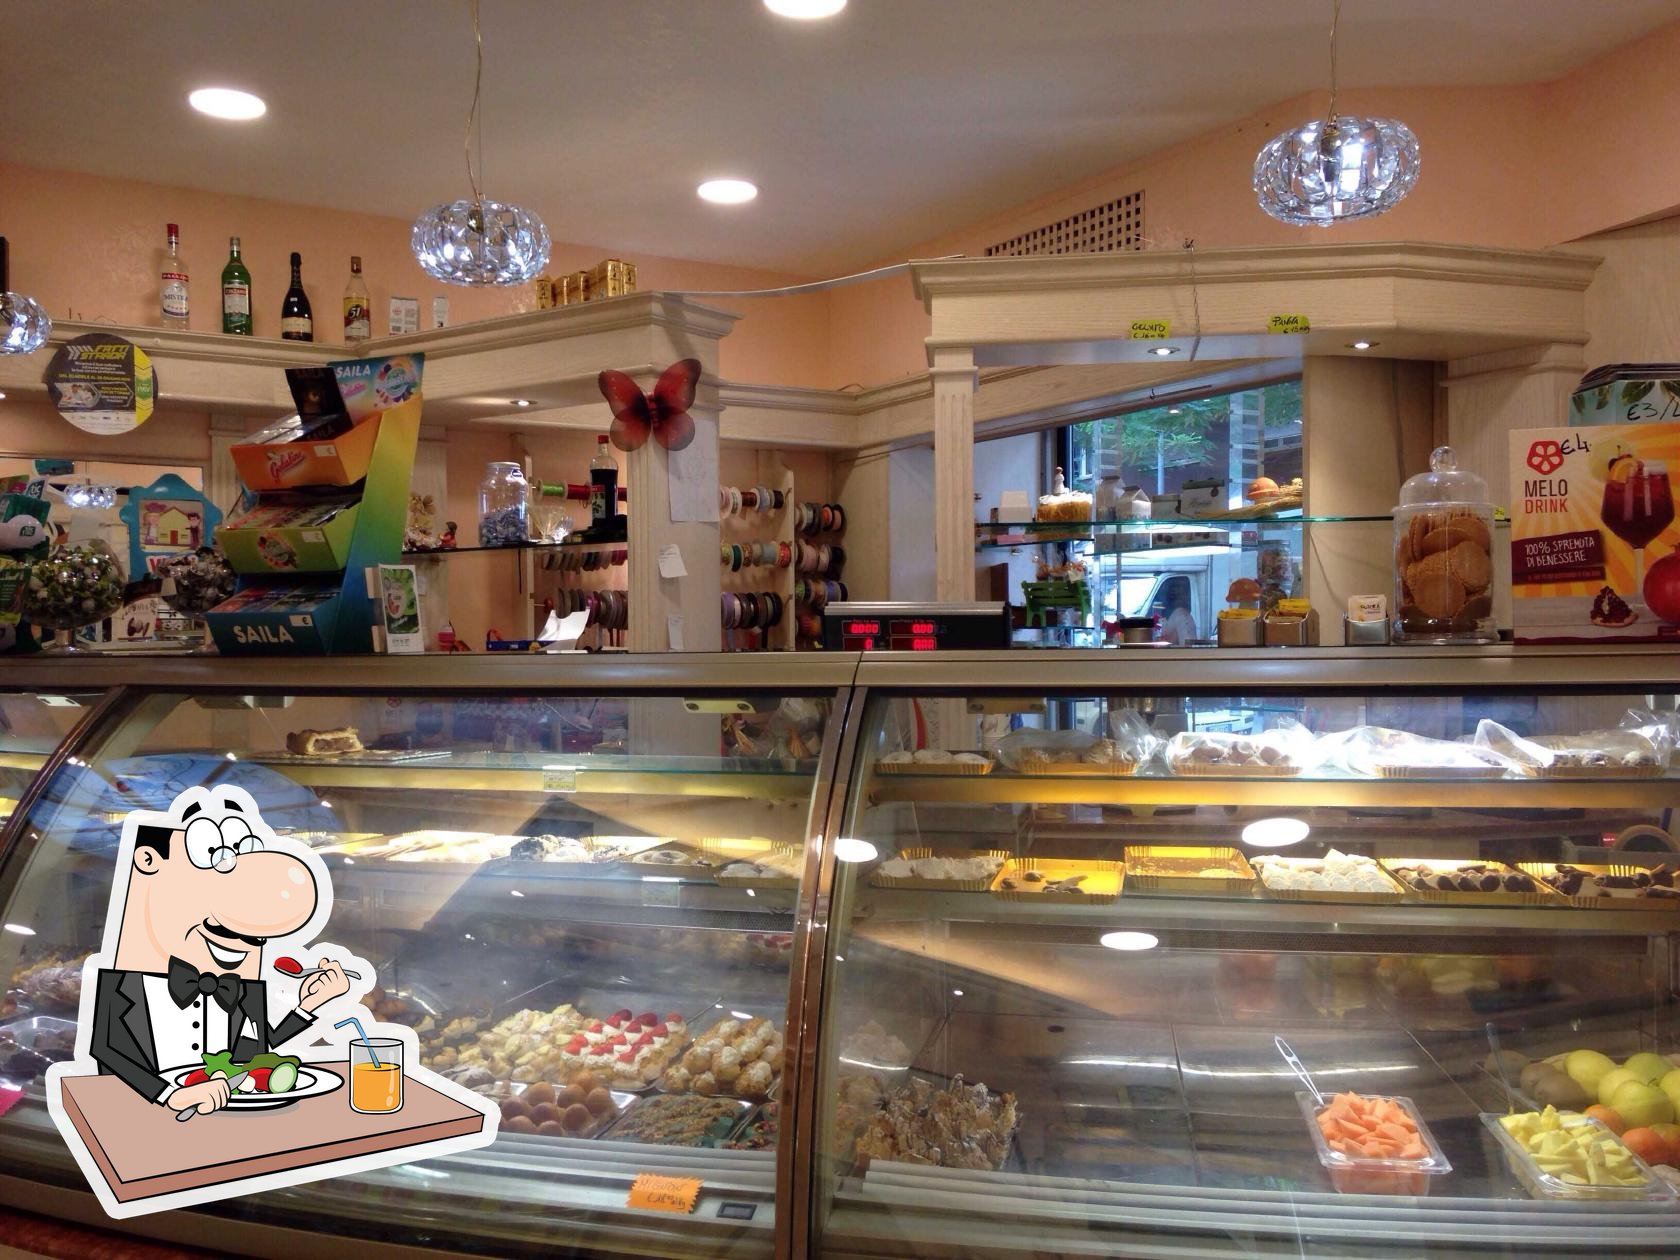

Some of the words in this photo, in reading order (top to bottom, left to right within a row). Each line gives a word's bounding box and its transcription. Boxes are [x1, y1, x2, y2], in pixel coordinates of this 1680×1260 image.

[335, 364, 371, 378] SAILA
[1524, 479, 1568, 498] MELO
[1525, 498, 1568, 514] DRINK
[1525, 541, 1551, 556] 100%
[1553, 536, 1595, 552] SPREMUTA
[1526, 557, 1535, 568] DI
[1537, 551, 1586, 567] BENESSERE
[233, 625, 294, 644] SAILA
